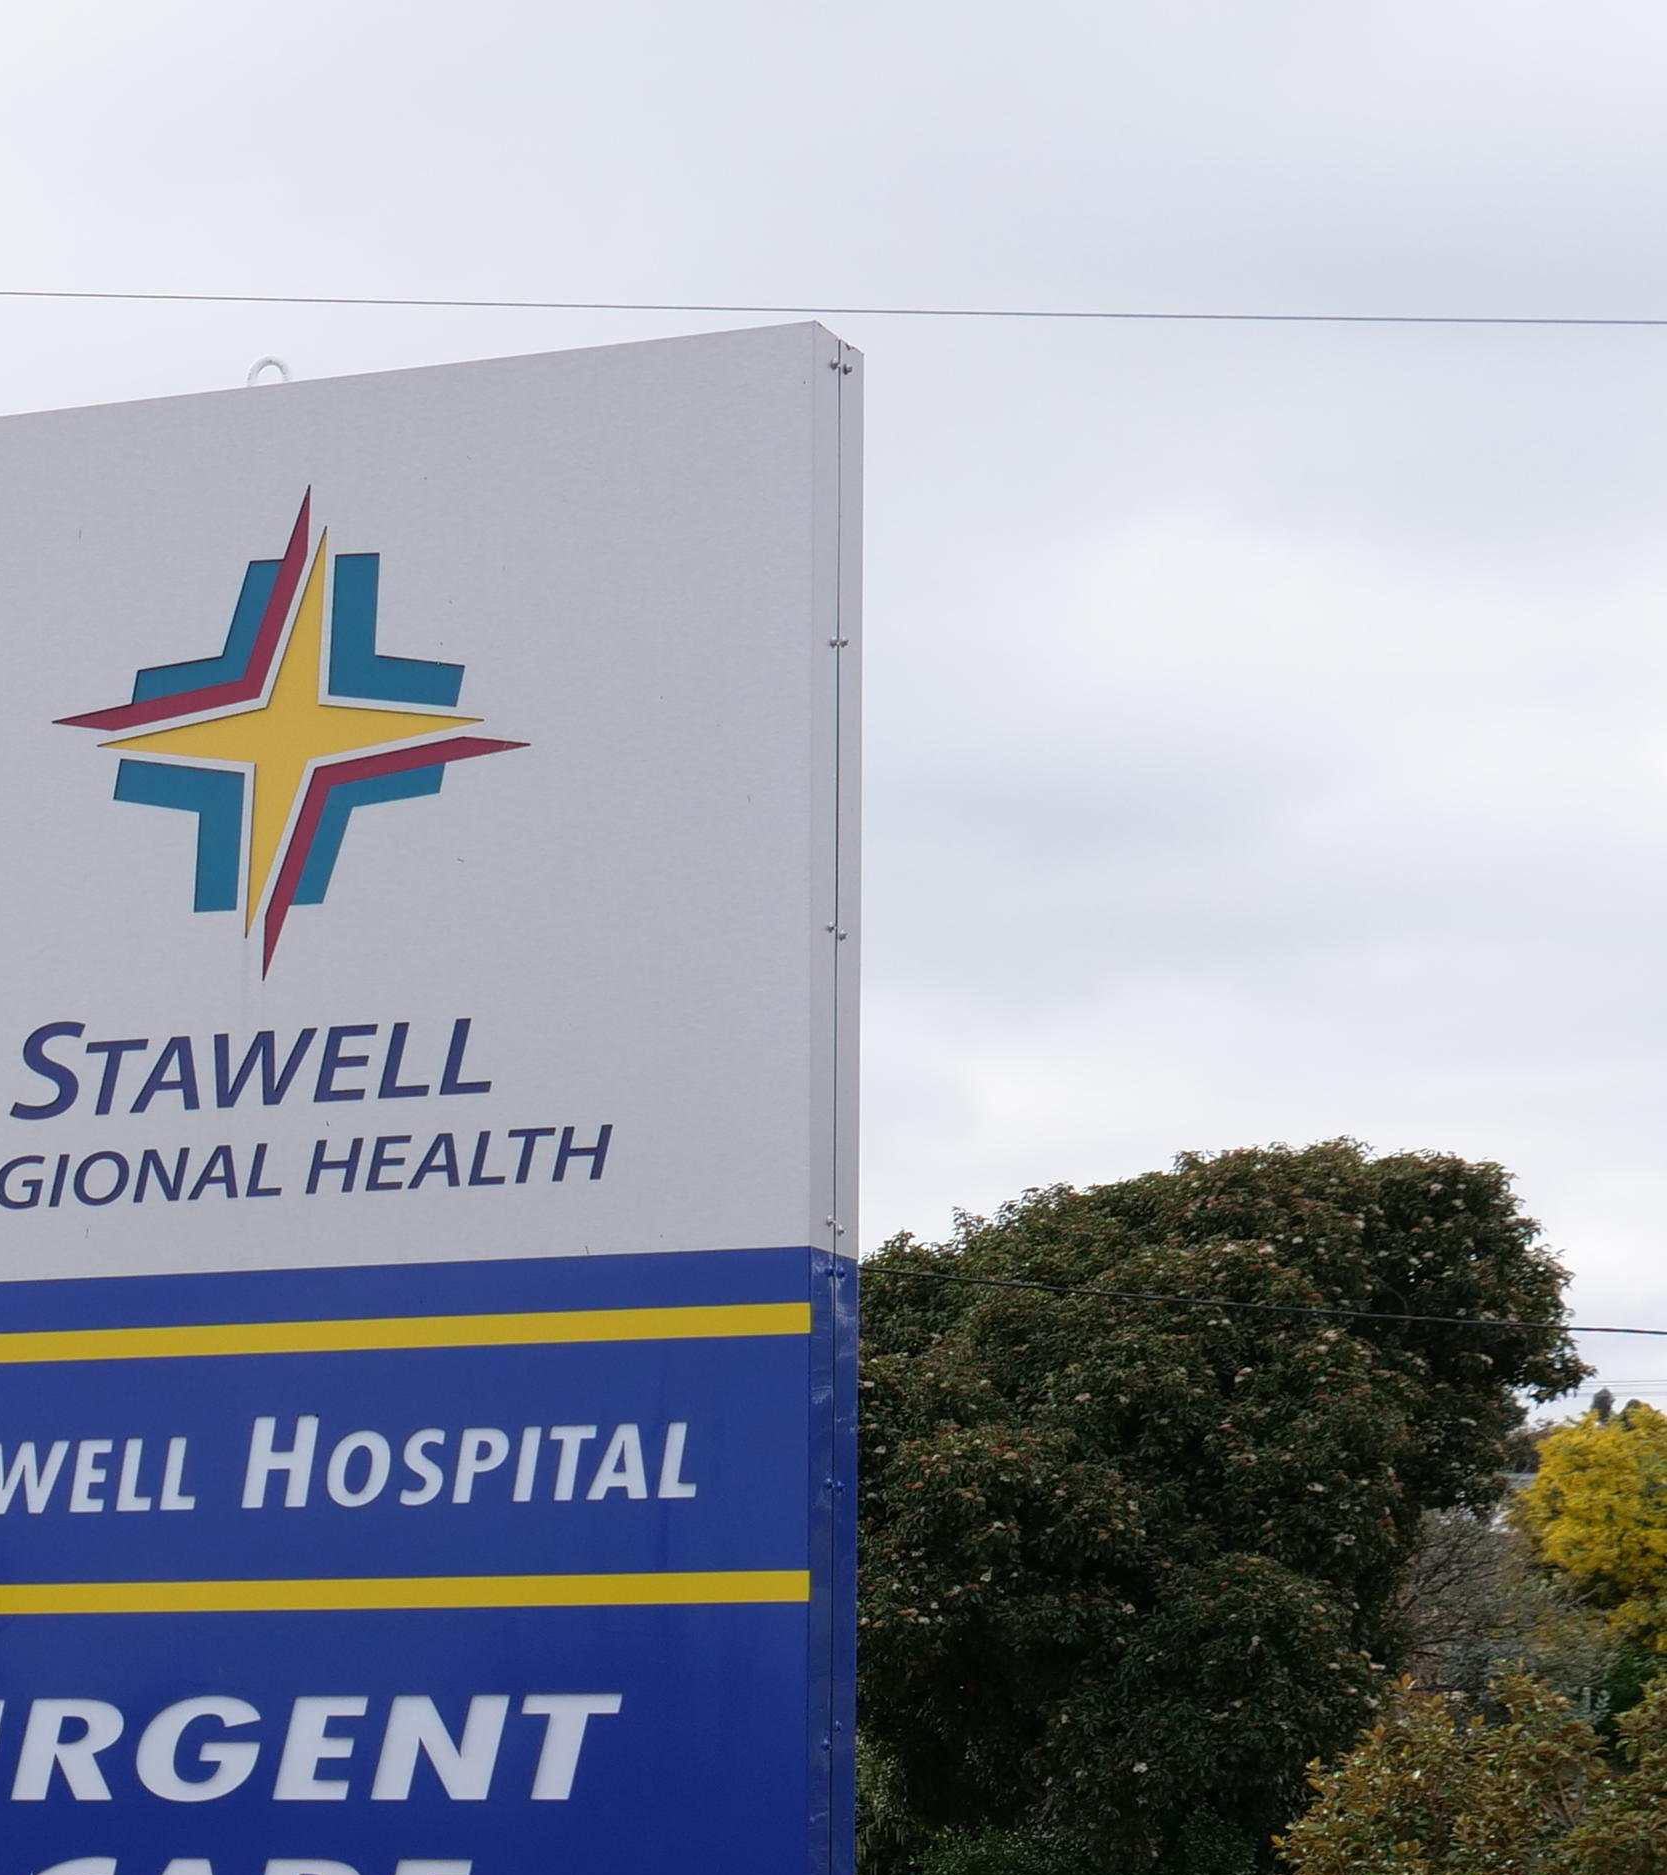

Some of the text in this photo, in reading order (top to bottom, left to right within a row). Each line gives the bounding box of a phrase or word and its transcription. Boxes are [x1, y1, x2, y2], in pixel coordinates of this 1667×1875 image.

[9, 1018, 494, 1121] STAWELL
[305, 1124, 613, 1195] HEALTH
[241, 1416, 698, 1509] HOSPITAL
